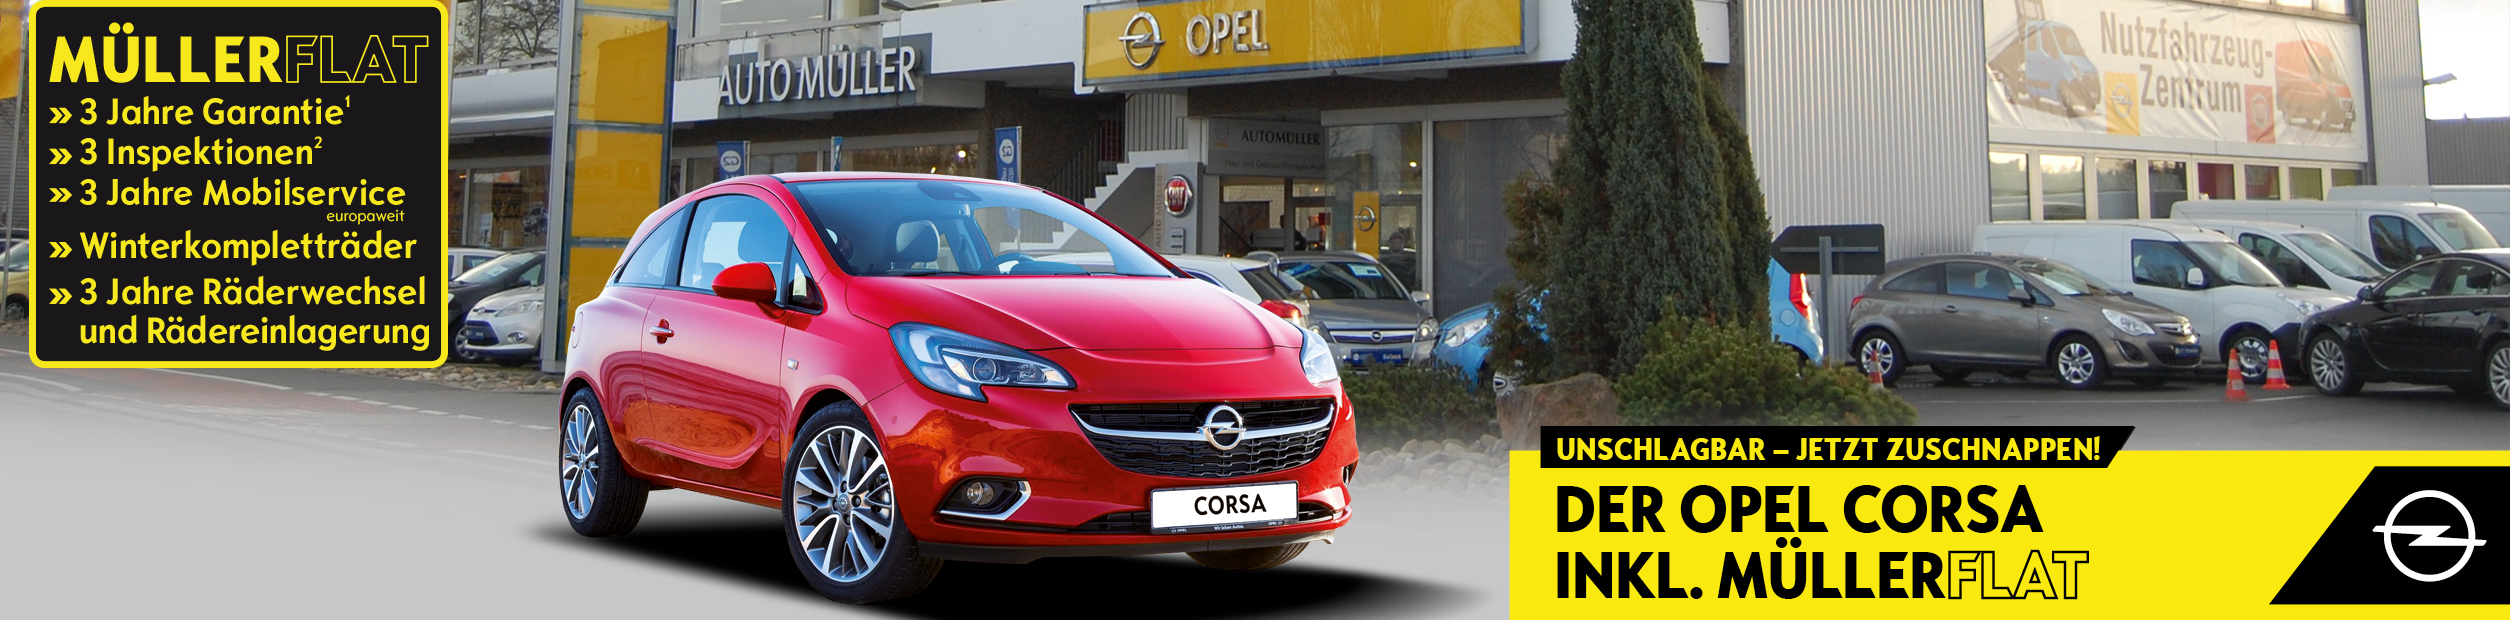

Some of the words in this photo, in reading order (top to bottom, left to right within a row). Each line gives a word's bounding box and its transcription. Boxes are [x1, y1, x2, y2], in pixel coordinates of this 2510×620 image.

[1186, 9, 1270, 56] OPEL
[2100, 11, 2273, 78] Nutzfahrzeug-
[718, 58, 793, 106] AUTO
[798, 44, 919, 99] MÜLLER
[2140, 64, 2242, 113] Zentrum
[1194, 493, 1267, 516] CORSA
